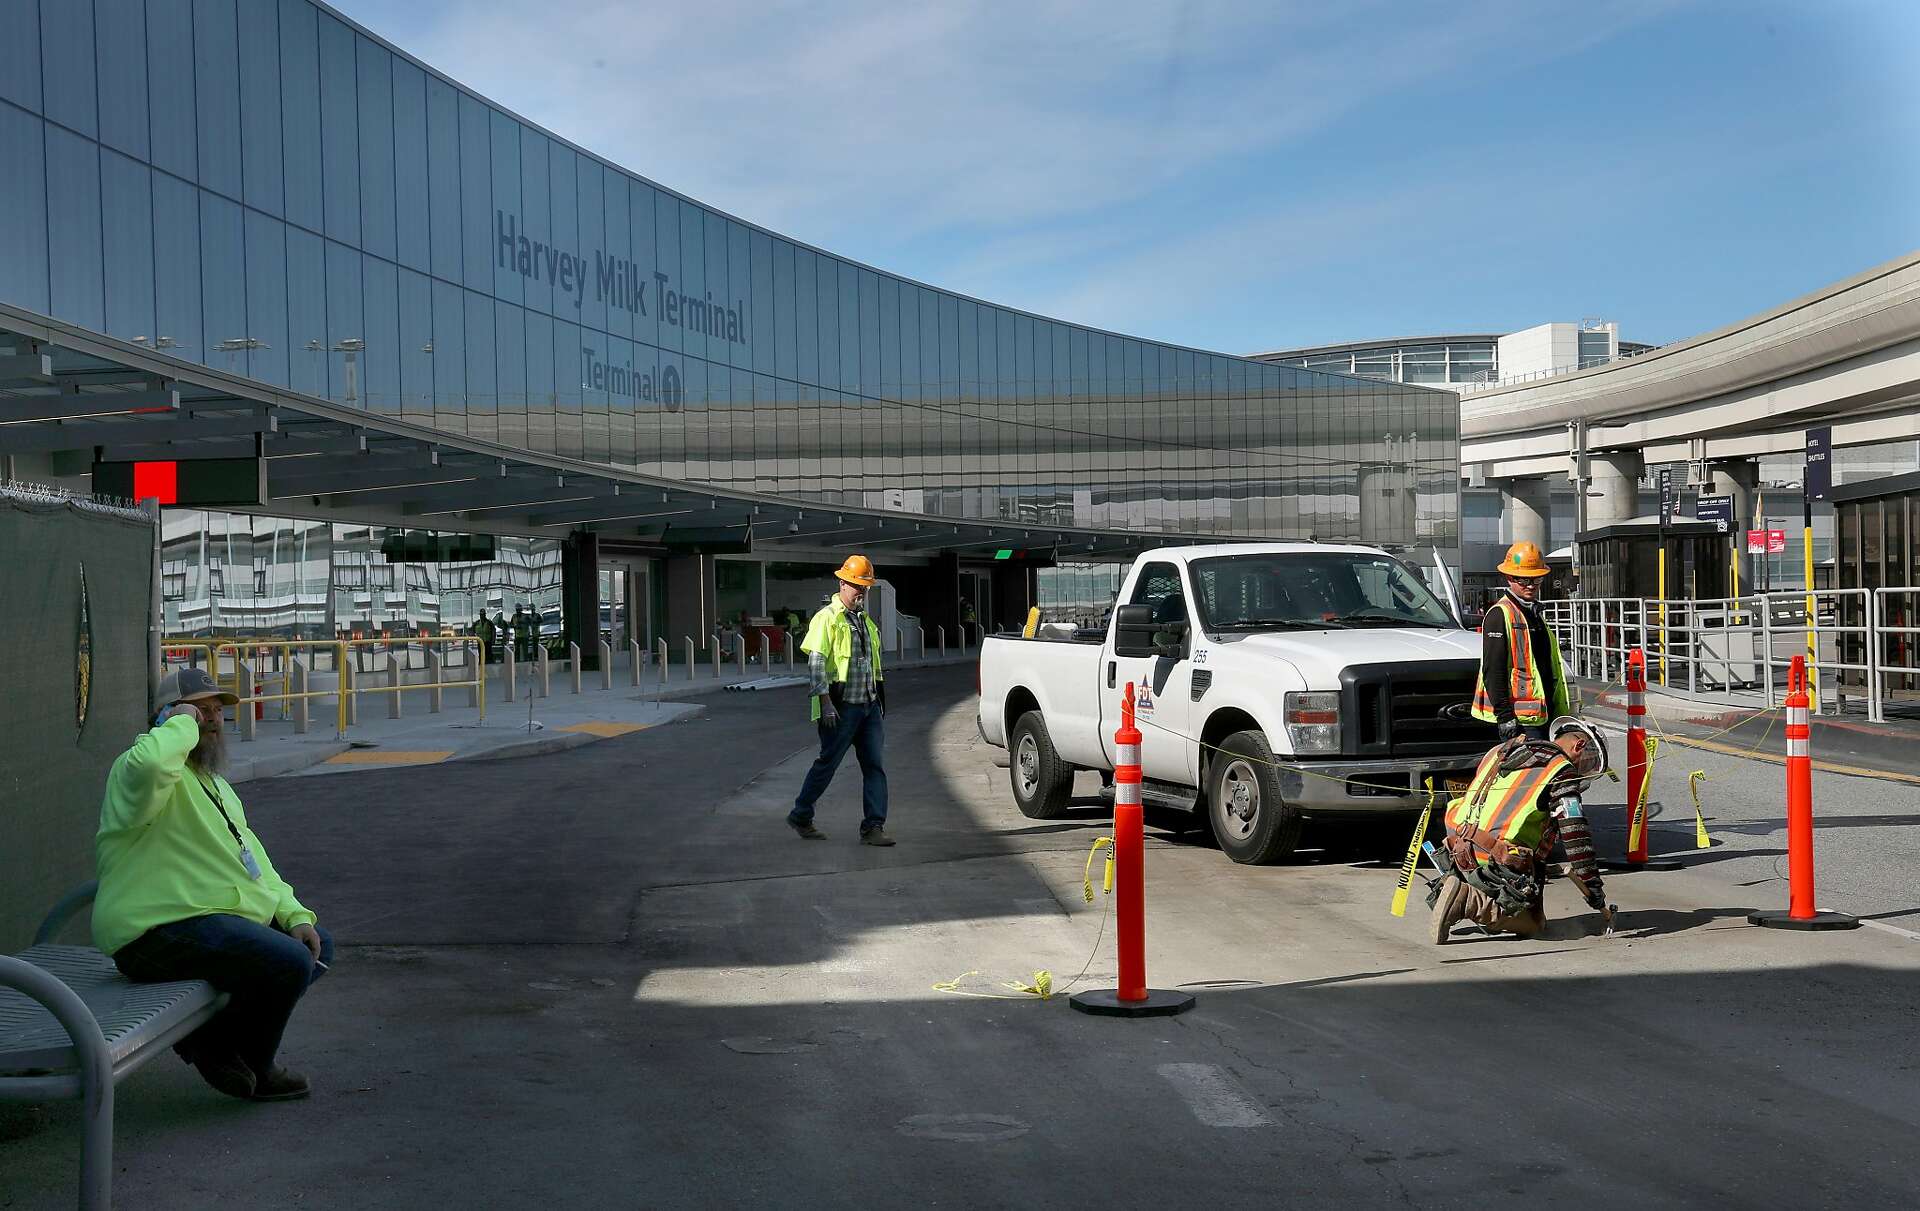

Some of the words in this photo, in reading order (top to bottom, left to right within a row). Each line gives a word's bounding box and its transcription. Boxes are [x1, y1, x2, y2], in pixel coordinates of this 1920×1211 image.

[497, 210, 587, 310] Harvey
[596, 250, 647, 317] Milk
[654, 271, 746, 345] Terminal
[583, 347, 658, 403] Terminal
[1808, 453, 1825, 462] SHUTTLES
[1193, 650, 1208, 664] 255
[1397, 850, 1416, 890] CAUTION
